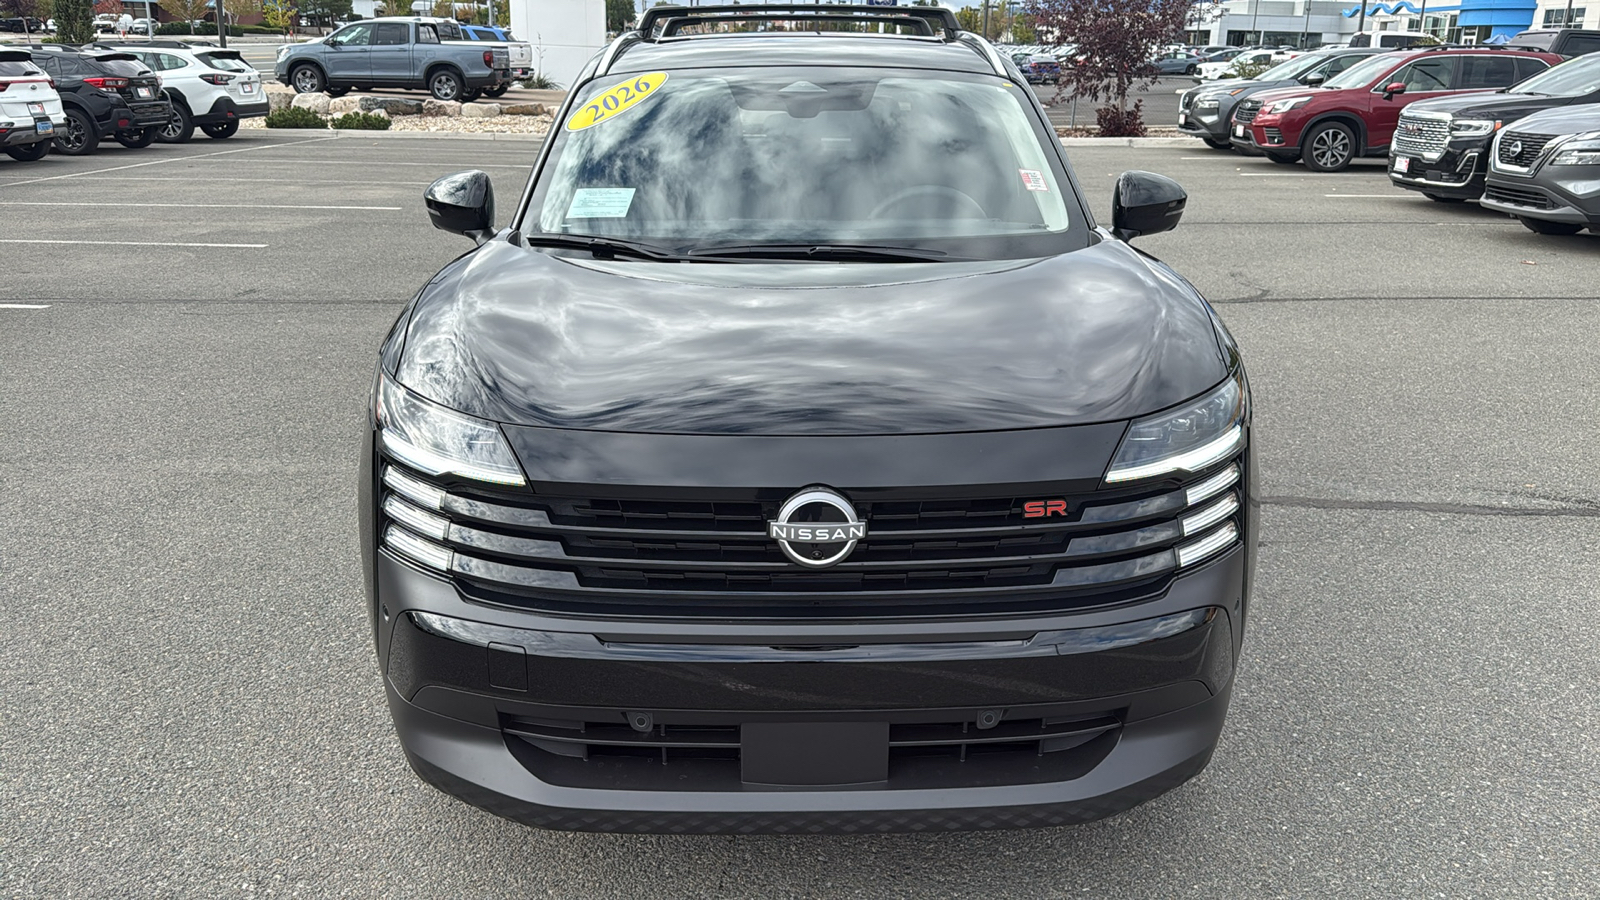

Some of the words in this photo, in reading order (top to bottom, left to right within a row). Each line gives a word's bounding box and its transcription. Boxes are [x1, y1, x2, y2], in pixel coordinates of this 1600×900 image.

[586, 77, 650, 122] 2026
[1024, 501, 1067, 517] SR
[772, 525, 864, 540] NISSAN
